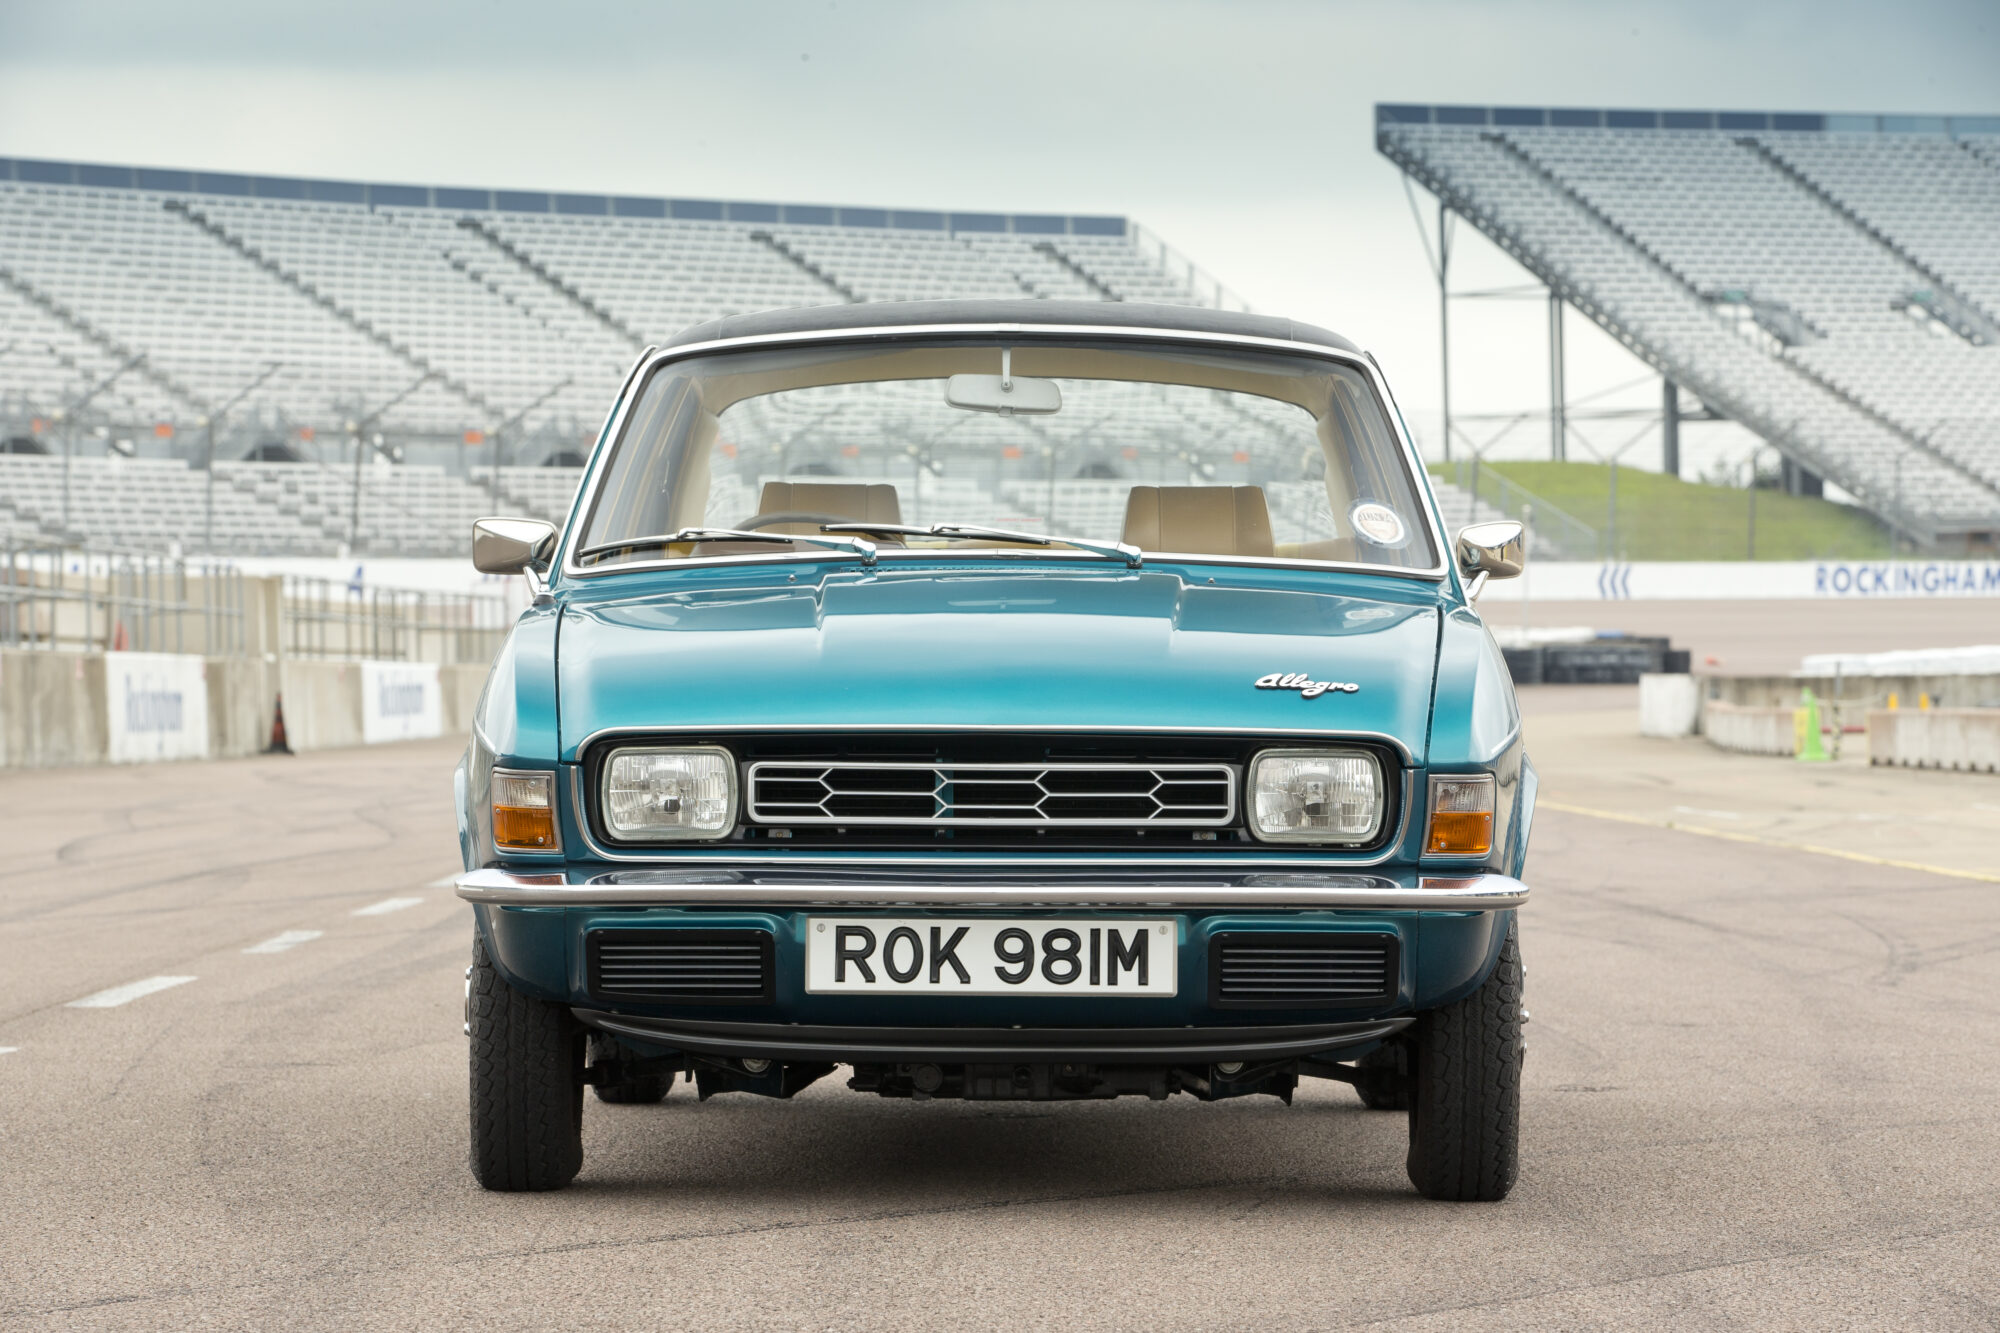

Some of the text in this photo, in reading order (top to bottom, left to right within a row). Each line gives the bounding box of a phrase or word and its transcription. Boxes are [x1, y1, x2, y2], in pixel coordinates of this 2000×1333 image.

[1815, 564, 2000, 593] ROCKINGHAM
[1254, 673, 1360, 699] Allegro
[834, 925, 1149, 986] ROK 981M
